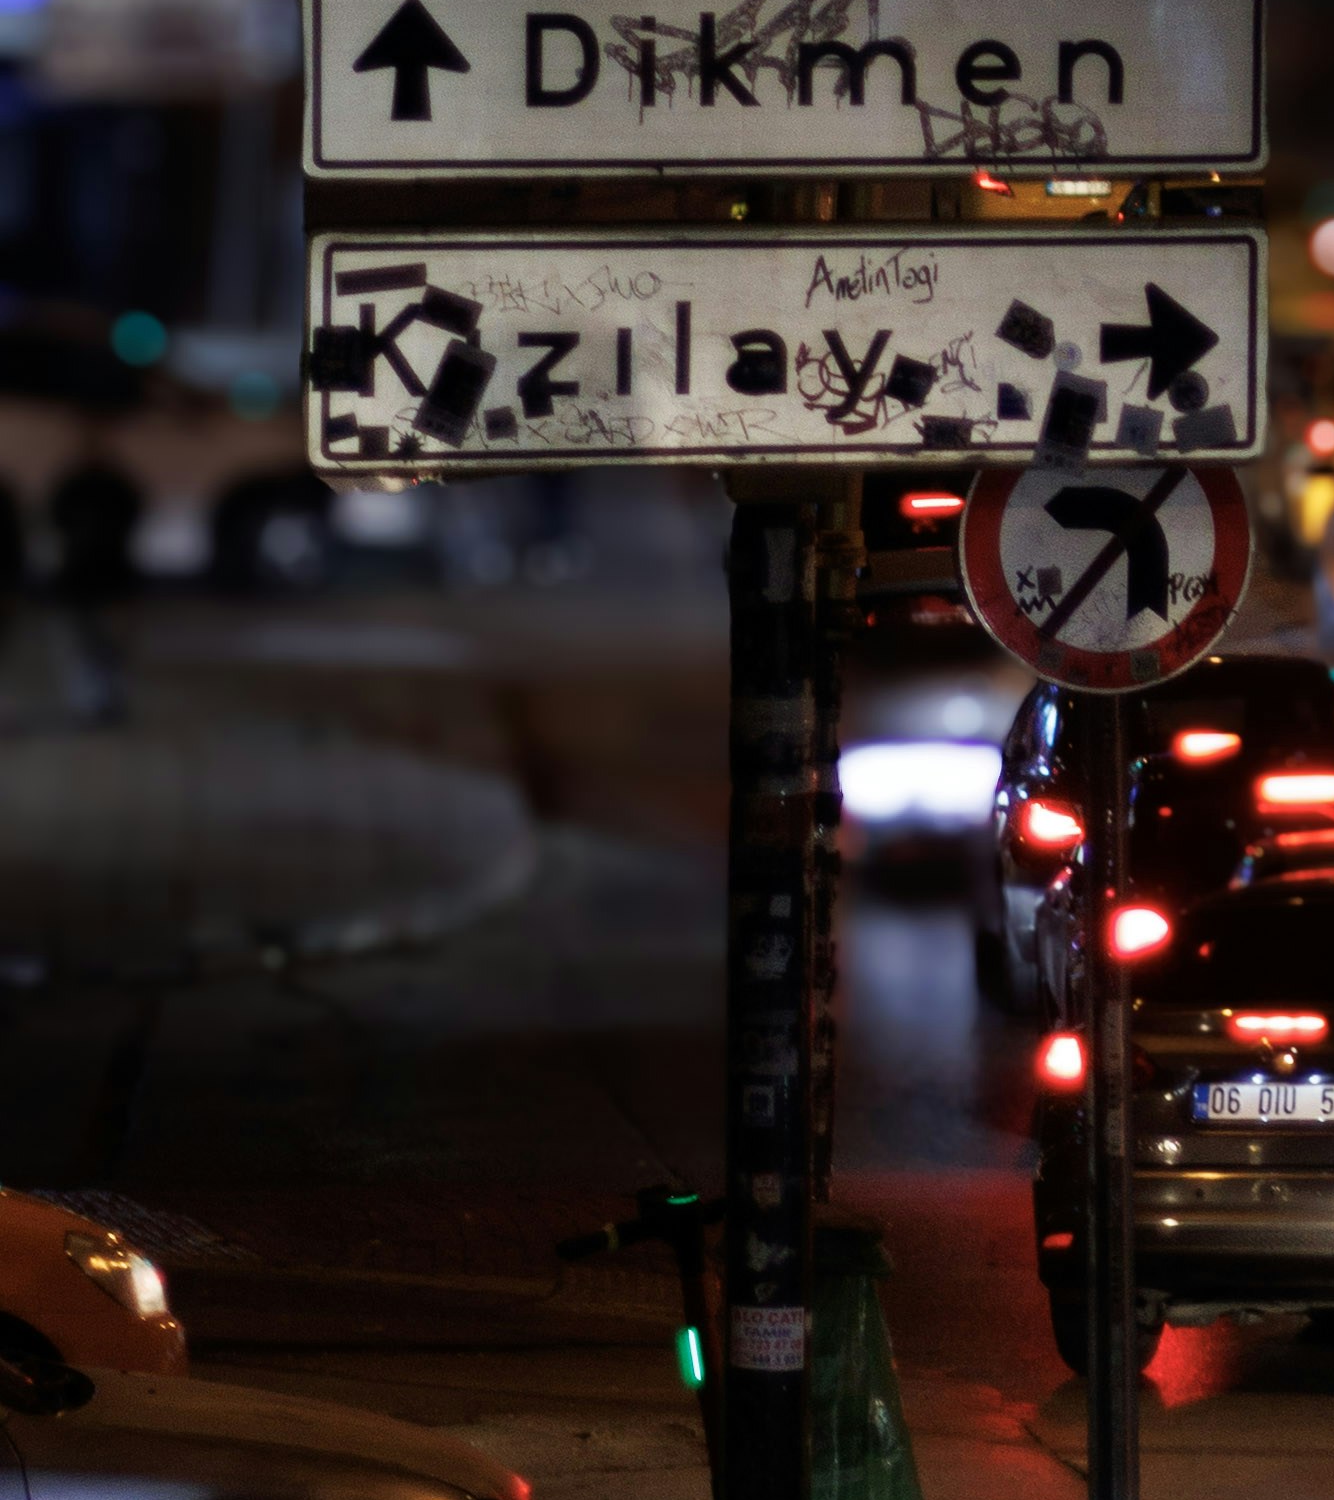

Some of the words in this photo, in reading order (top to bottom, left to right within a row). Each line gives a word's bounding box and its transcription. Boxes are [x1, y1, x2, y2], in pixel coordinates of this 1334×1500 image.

[525, 13, 1124, 107] Dikmen
[359, 300, 893, 422] Kzılay
[1211, 1087, 1241, 1114] 06
